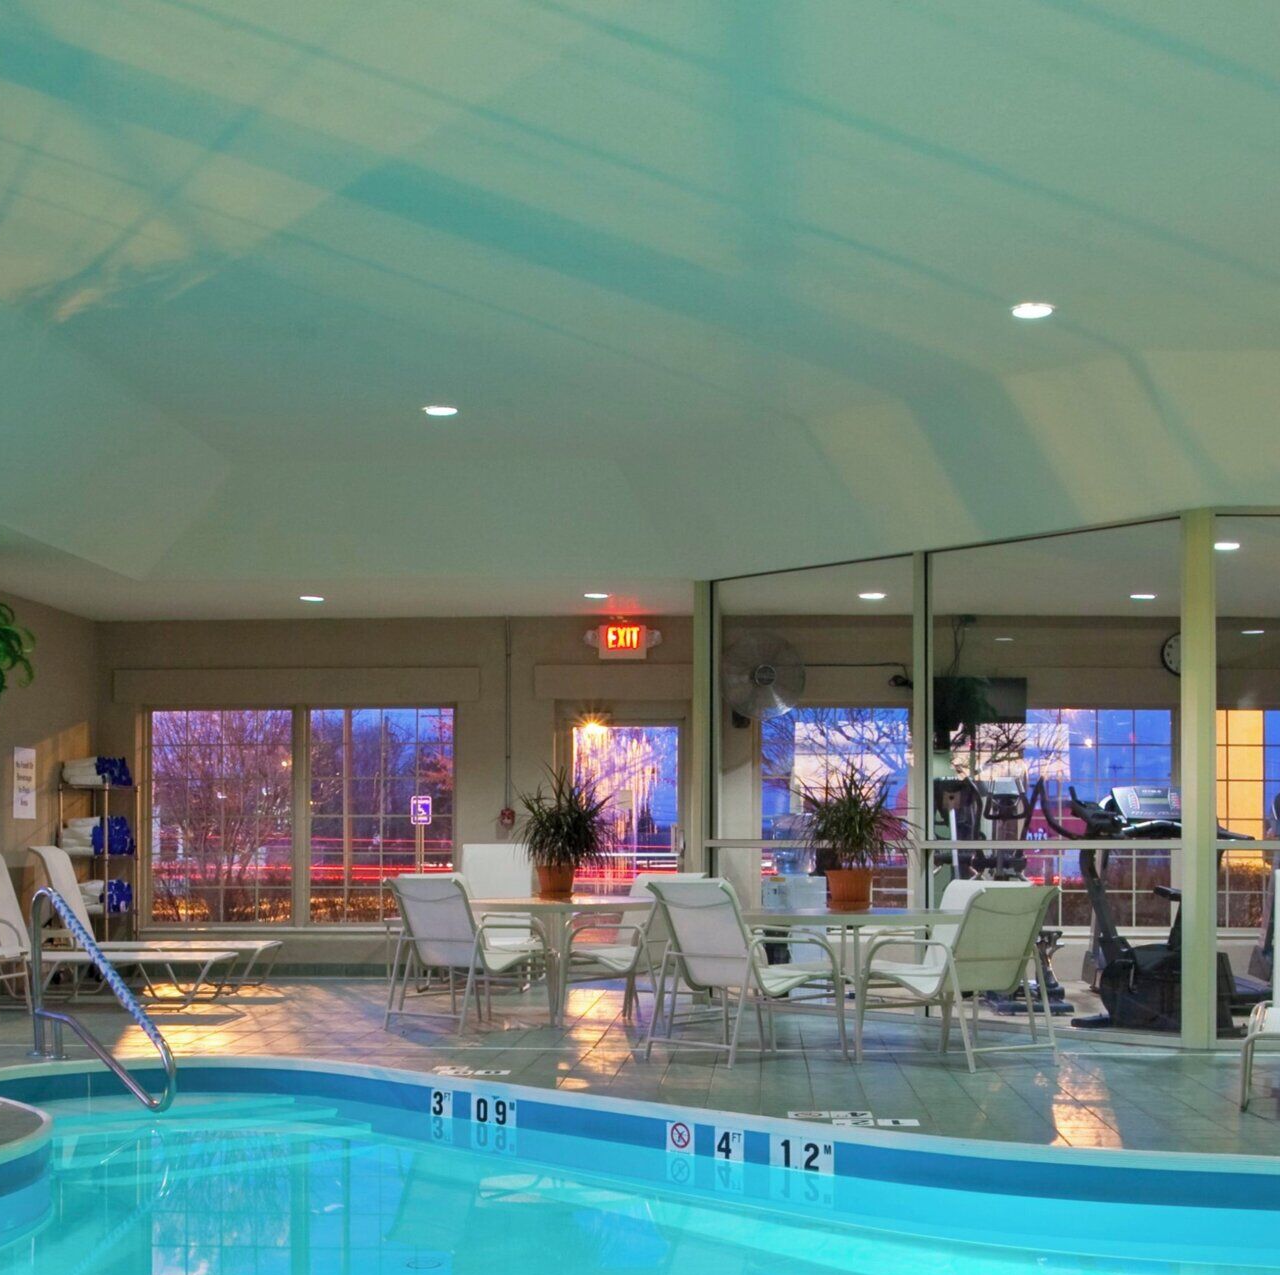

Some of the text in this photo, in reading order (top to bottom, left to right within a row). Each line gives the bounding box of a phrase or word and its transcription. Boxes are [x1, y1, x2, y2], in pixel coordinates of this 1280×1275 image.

[608, 627, 639, 648] EXIT
[433, 1091, 444, 1115] 3
[717, 1131, 732, 1159] 4
